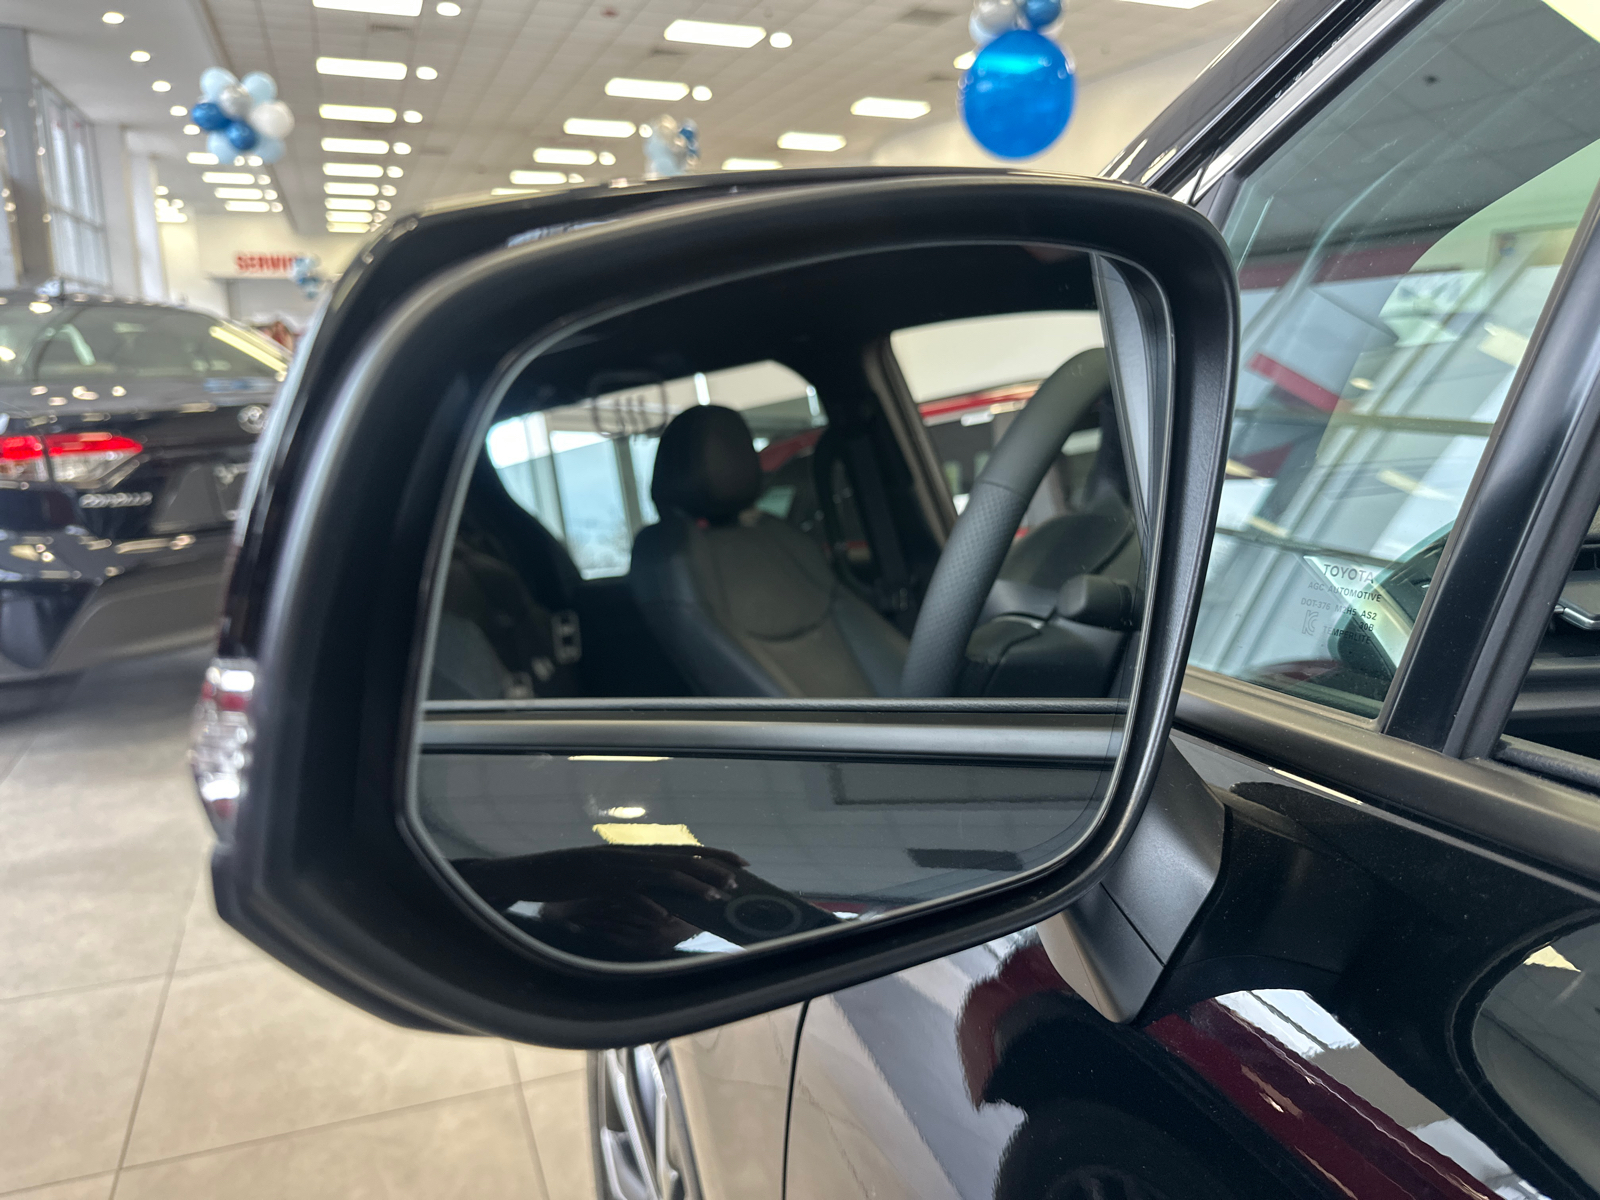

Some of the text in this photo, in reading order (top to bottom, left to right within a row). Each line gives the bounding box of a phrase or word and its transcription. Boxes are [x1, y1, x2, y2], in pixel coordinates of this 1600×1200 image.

[1323, 564, 1375, 584] TOYOTA
[1308, 581, 1382, 603] AGC AUTOMOTIVE
[1300, 597, 1331, 611] DOT-376
[1360, 610, 1378, 621] AS2
[1322, 625, 1372, 645] TEMPERLITE
